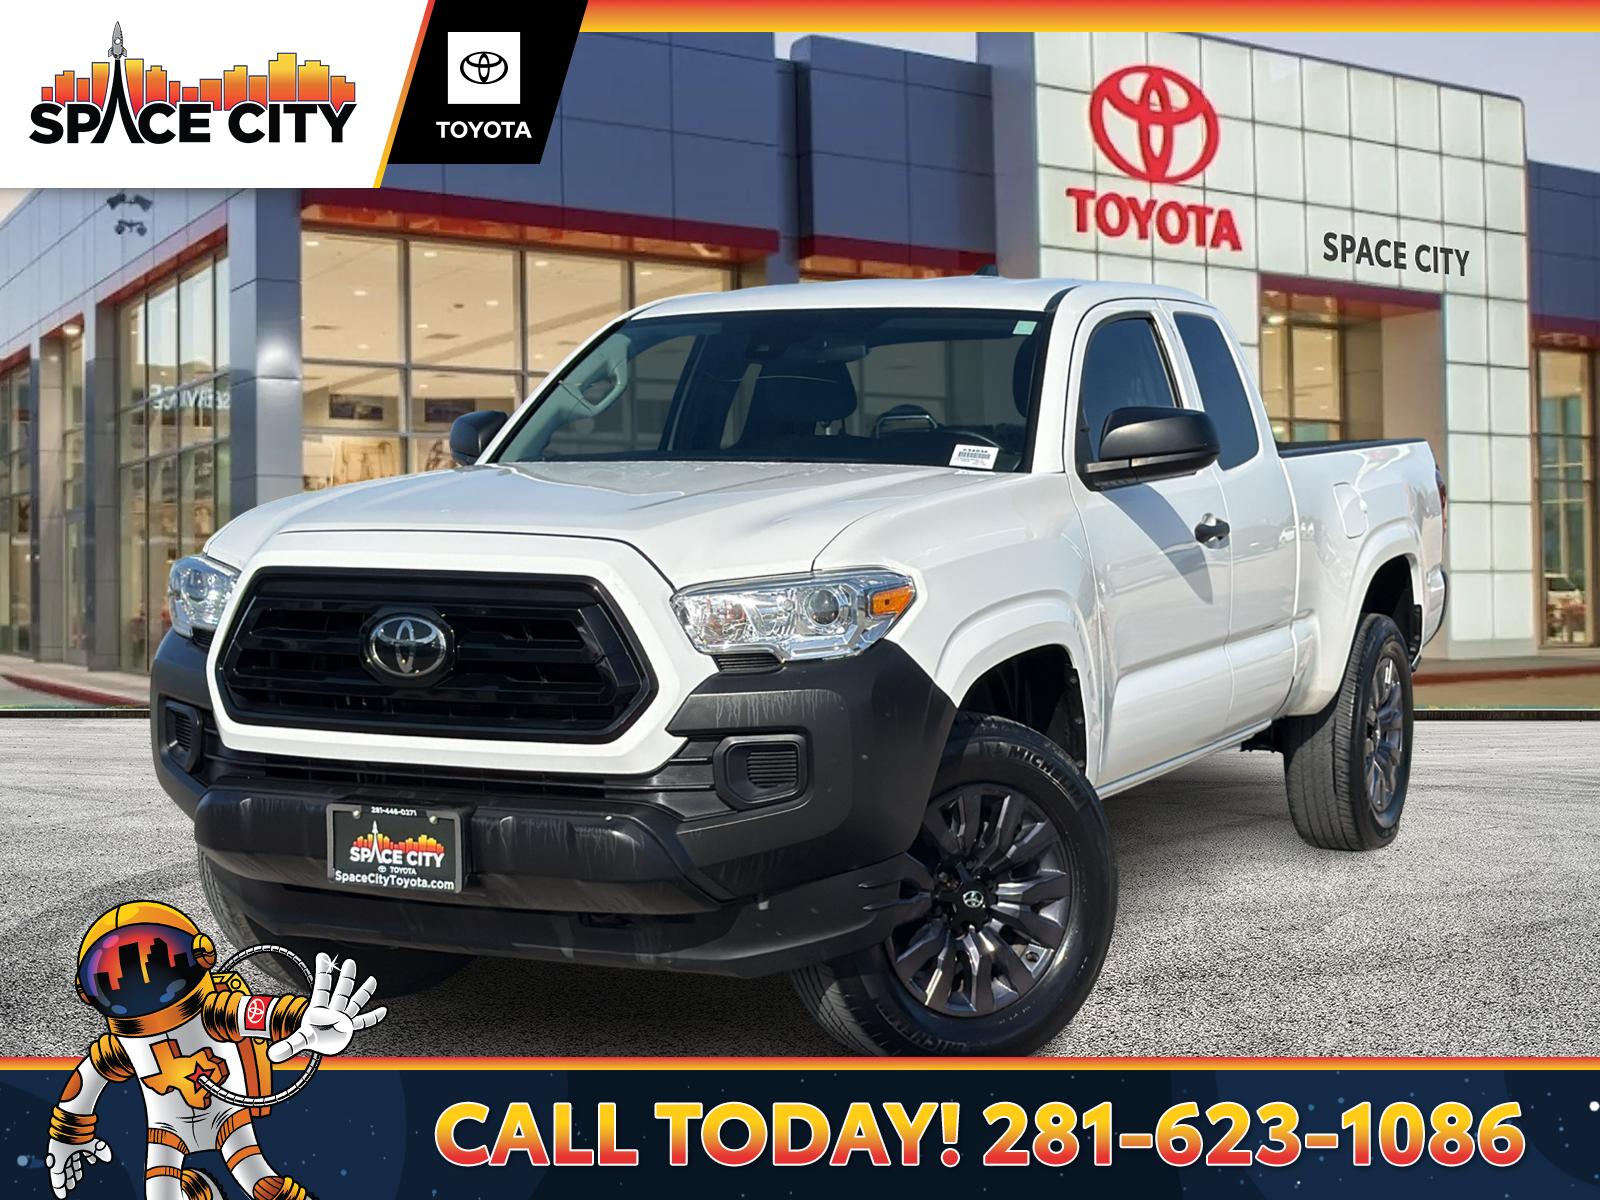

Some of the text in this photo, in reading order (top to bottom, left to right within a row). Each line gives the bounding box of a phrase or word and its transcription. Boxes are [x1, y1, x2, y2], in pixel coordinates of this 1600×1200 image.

[1066, 187, 1243, 252] TOYOTA
[1323, 232, 1470, 277] SPACE CITY
[349, 845, 445, 868] SPACE CITY
[335, 870, 455, 890] SpaceCityToyota.com
[389, 866, 417, 875] TOYOTA
